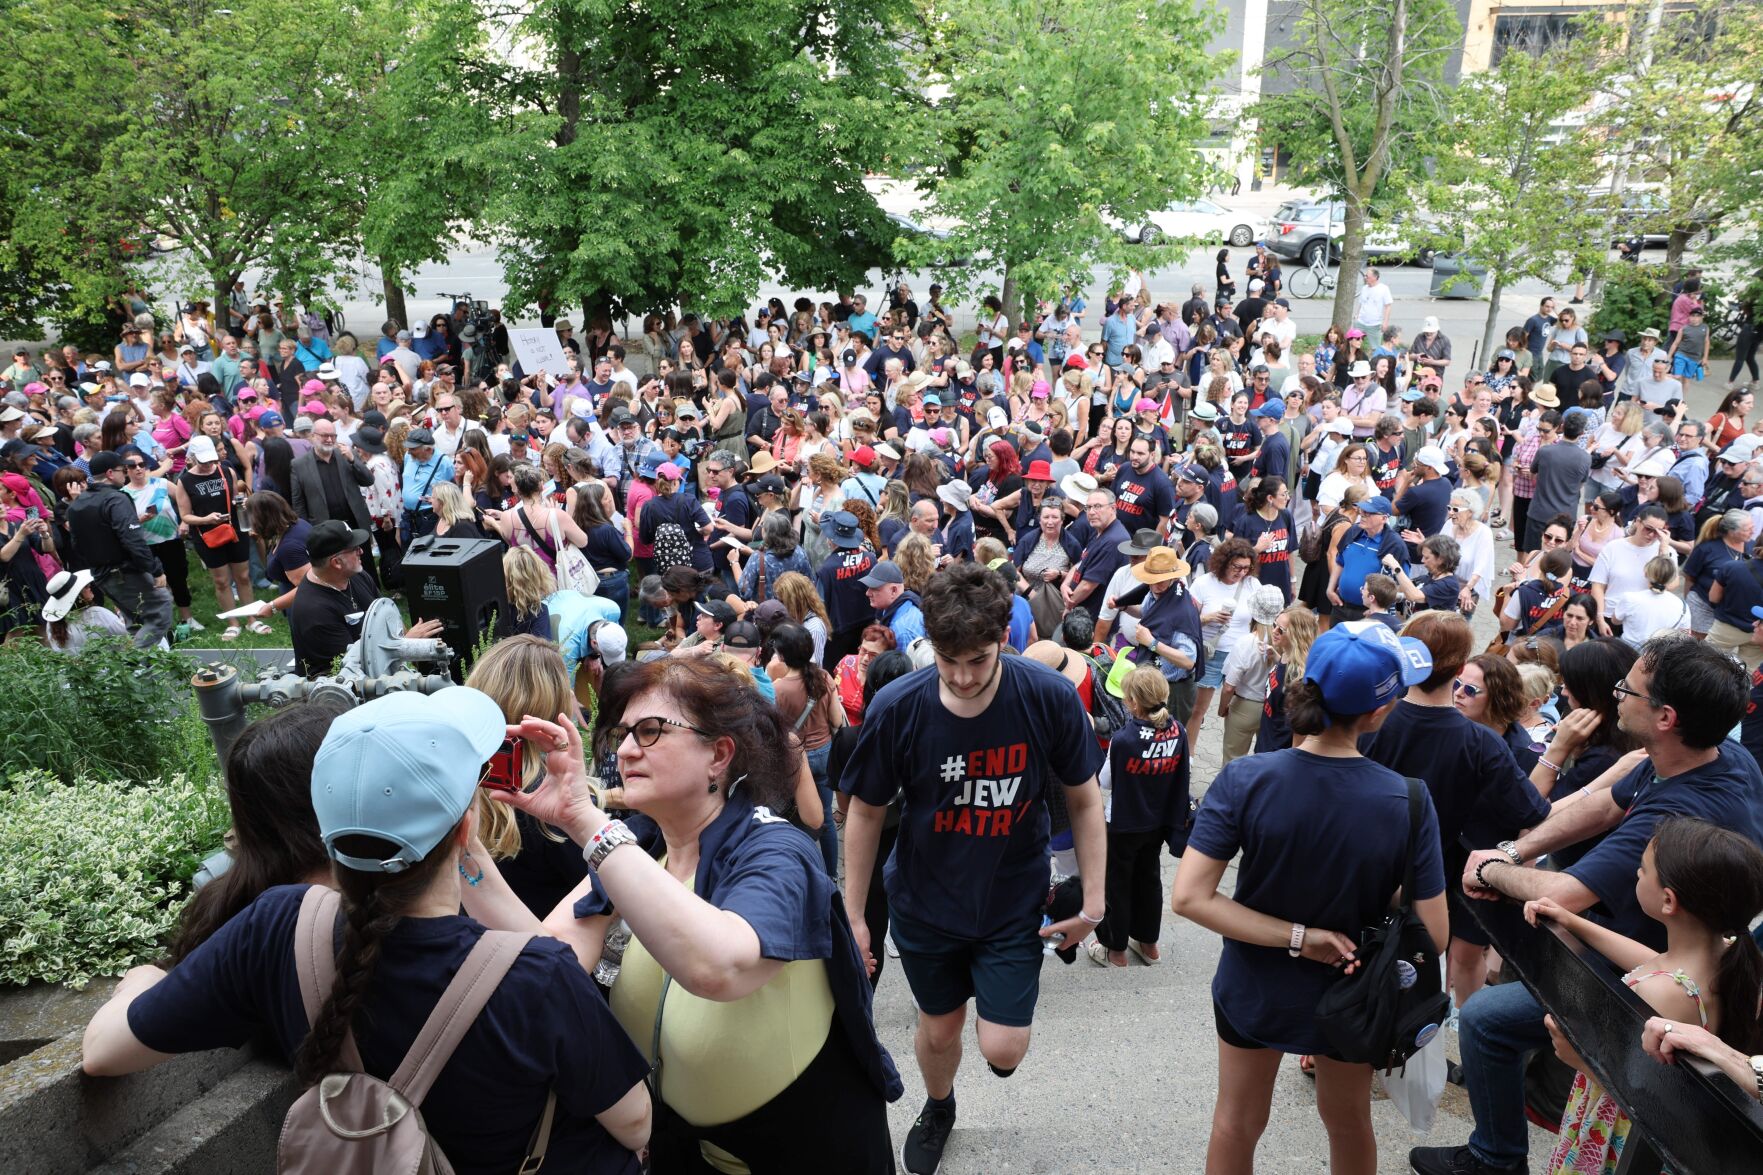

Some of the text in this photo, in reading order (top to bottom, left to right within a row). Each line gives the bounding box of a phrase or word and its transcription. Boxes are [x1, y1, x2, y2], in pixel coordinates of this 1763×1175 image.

[1226, 440, 1247, 449] JEW
[1120, 480, 1146, 496] #END
[1118, 491, 1139, 504] JEW
[842, 552, 864, 567] JEW
[1141, 738, 1179, 759] JEW
[939, 742, 1028, 783] #END
[953, 776, 1023, 808] JEW
